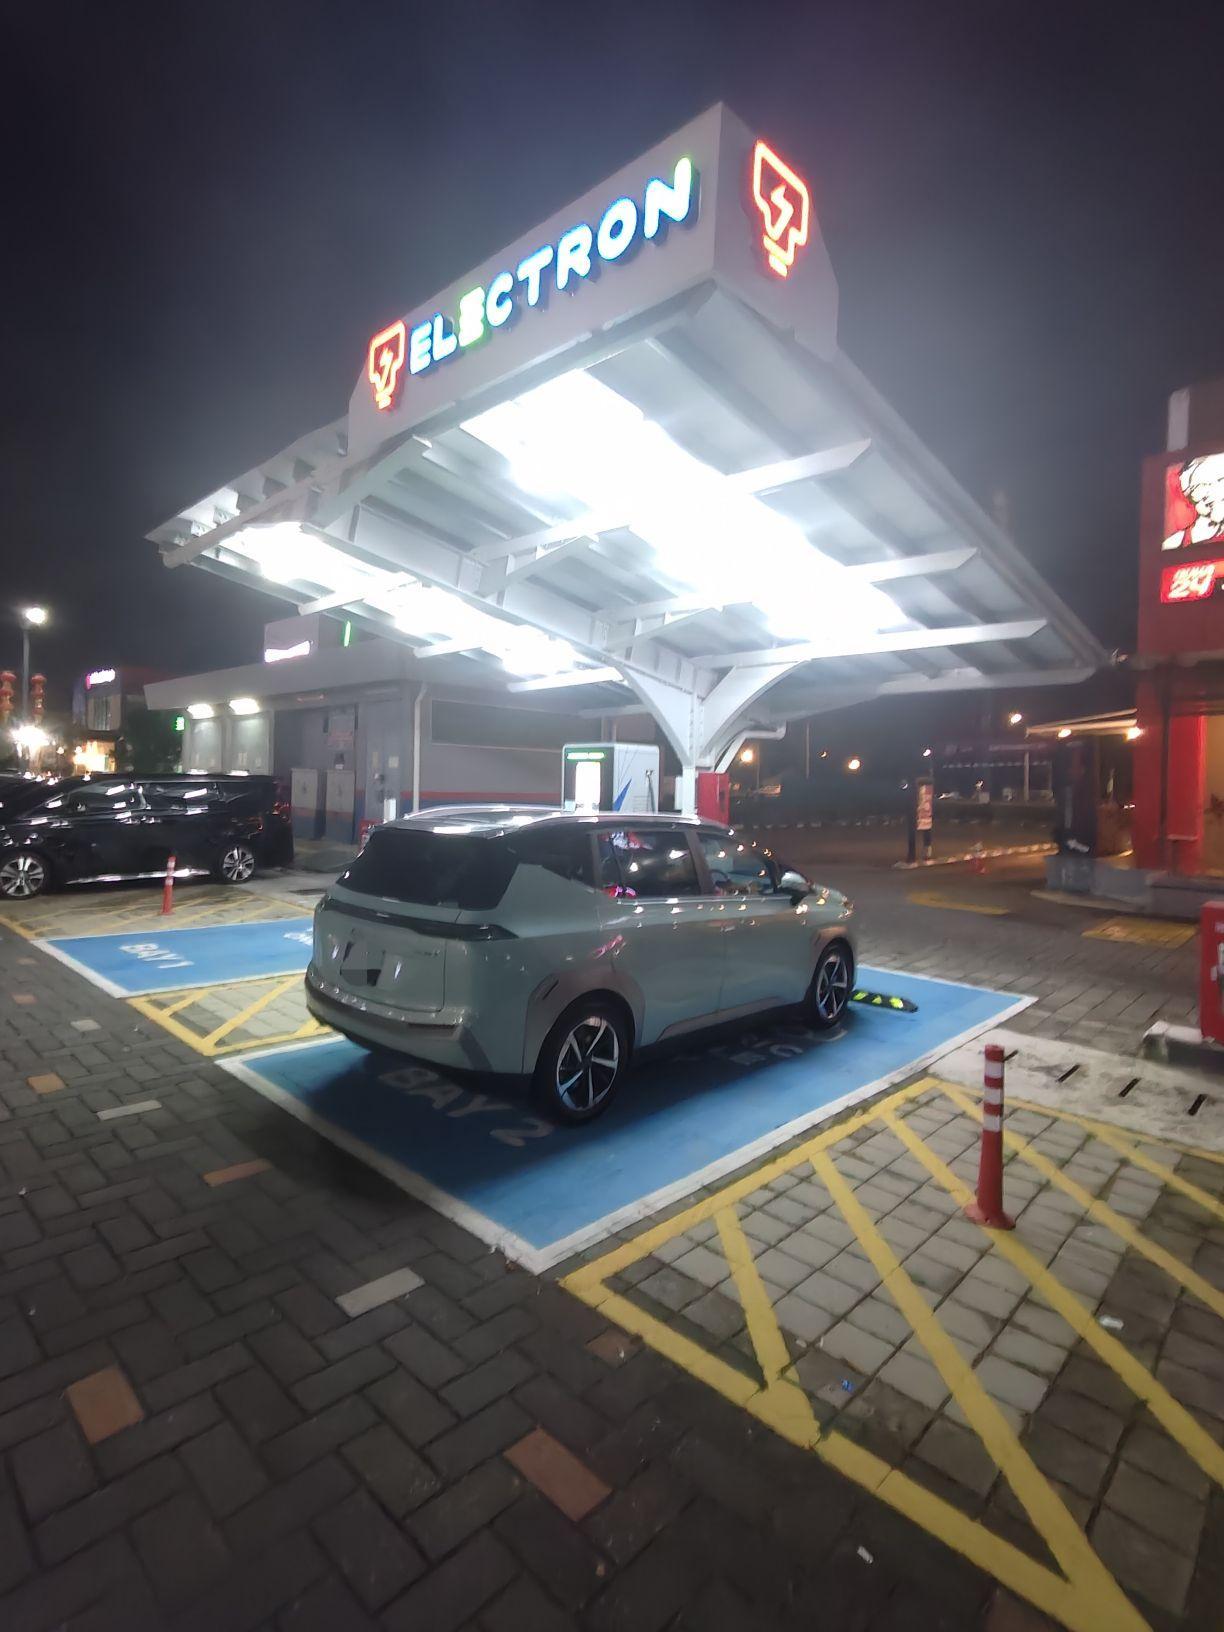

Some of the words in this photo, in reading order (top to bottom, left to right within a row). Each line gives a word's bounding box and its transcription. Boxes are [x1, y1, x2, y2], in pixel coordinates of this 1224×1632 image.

[409, 157, 693, 375] ELECTRON
[378, 1067, 513, 1118] BAY
[489, 1117, 555, 1147] 2
